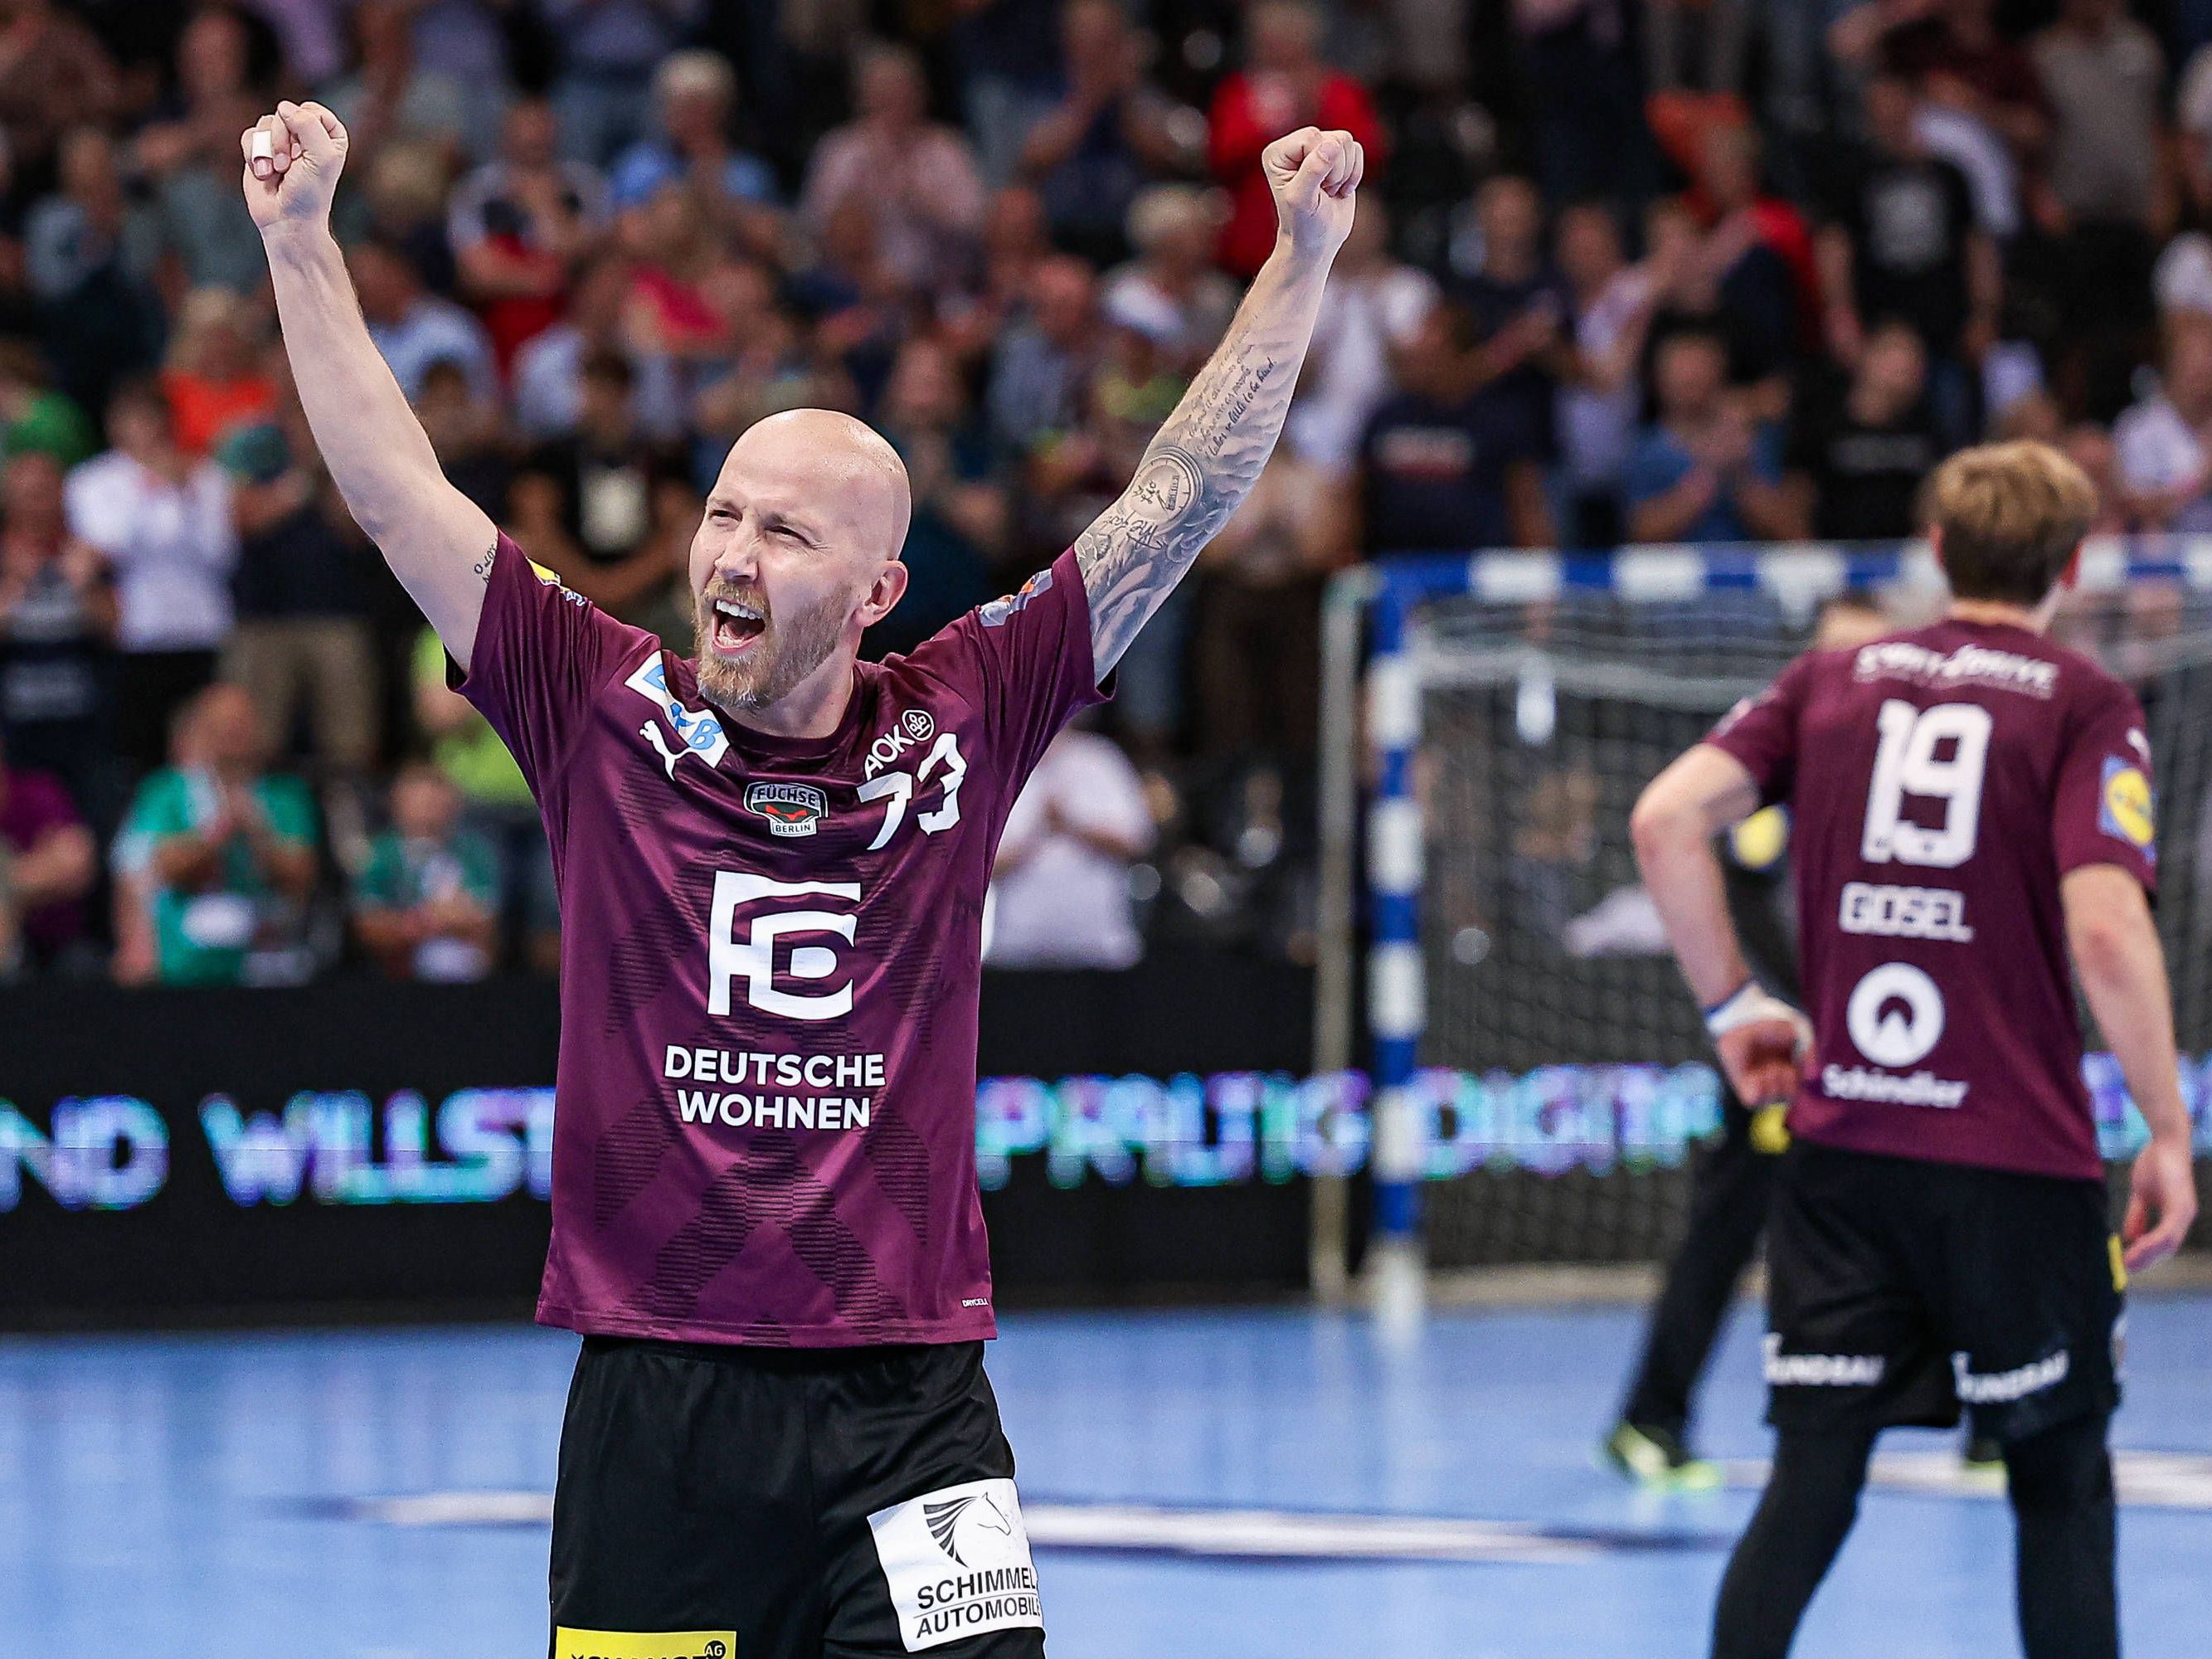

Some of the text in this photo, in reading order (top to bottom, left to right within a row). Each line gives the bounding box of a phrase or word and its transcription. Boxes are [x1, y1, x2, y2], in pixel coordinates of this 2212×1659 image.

[864, 724, 916, 781] AOK
[756, 786, 816, 806] FÜCHSE
[857, 733, 968, 850] 73
[1861, 698, 1992, 868] 19
[775, 824, 810, 833] BERLIN
[664, 1045, 886, 1087] DEUTSCHE
[677, 1089, 870, 1129] WOHNEN
[917, 1567, 1036, 1609] SCHIMMEL
[705, 1645, 723, 1657] AG
